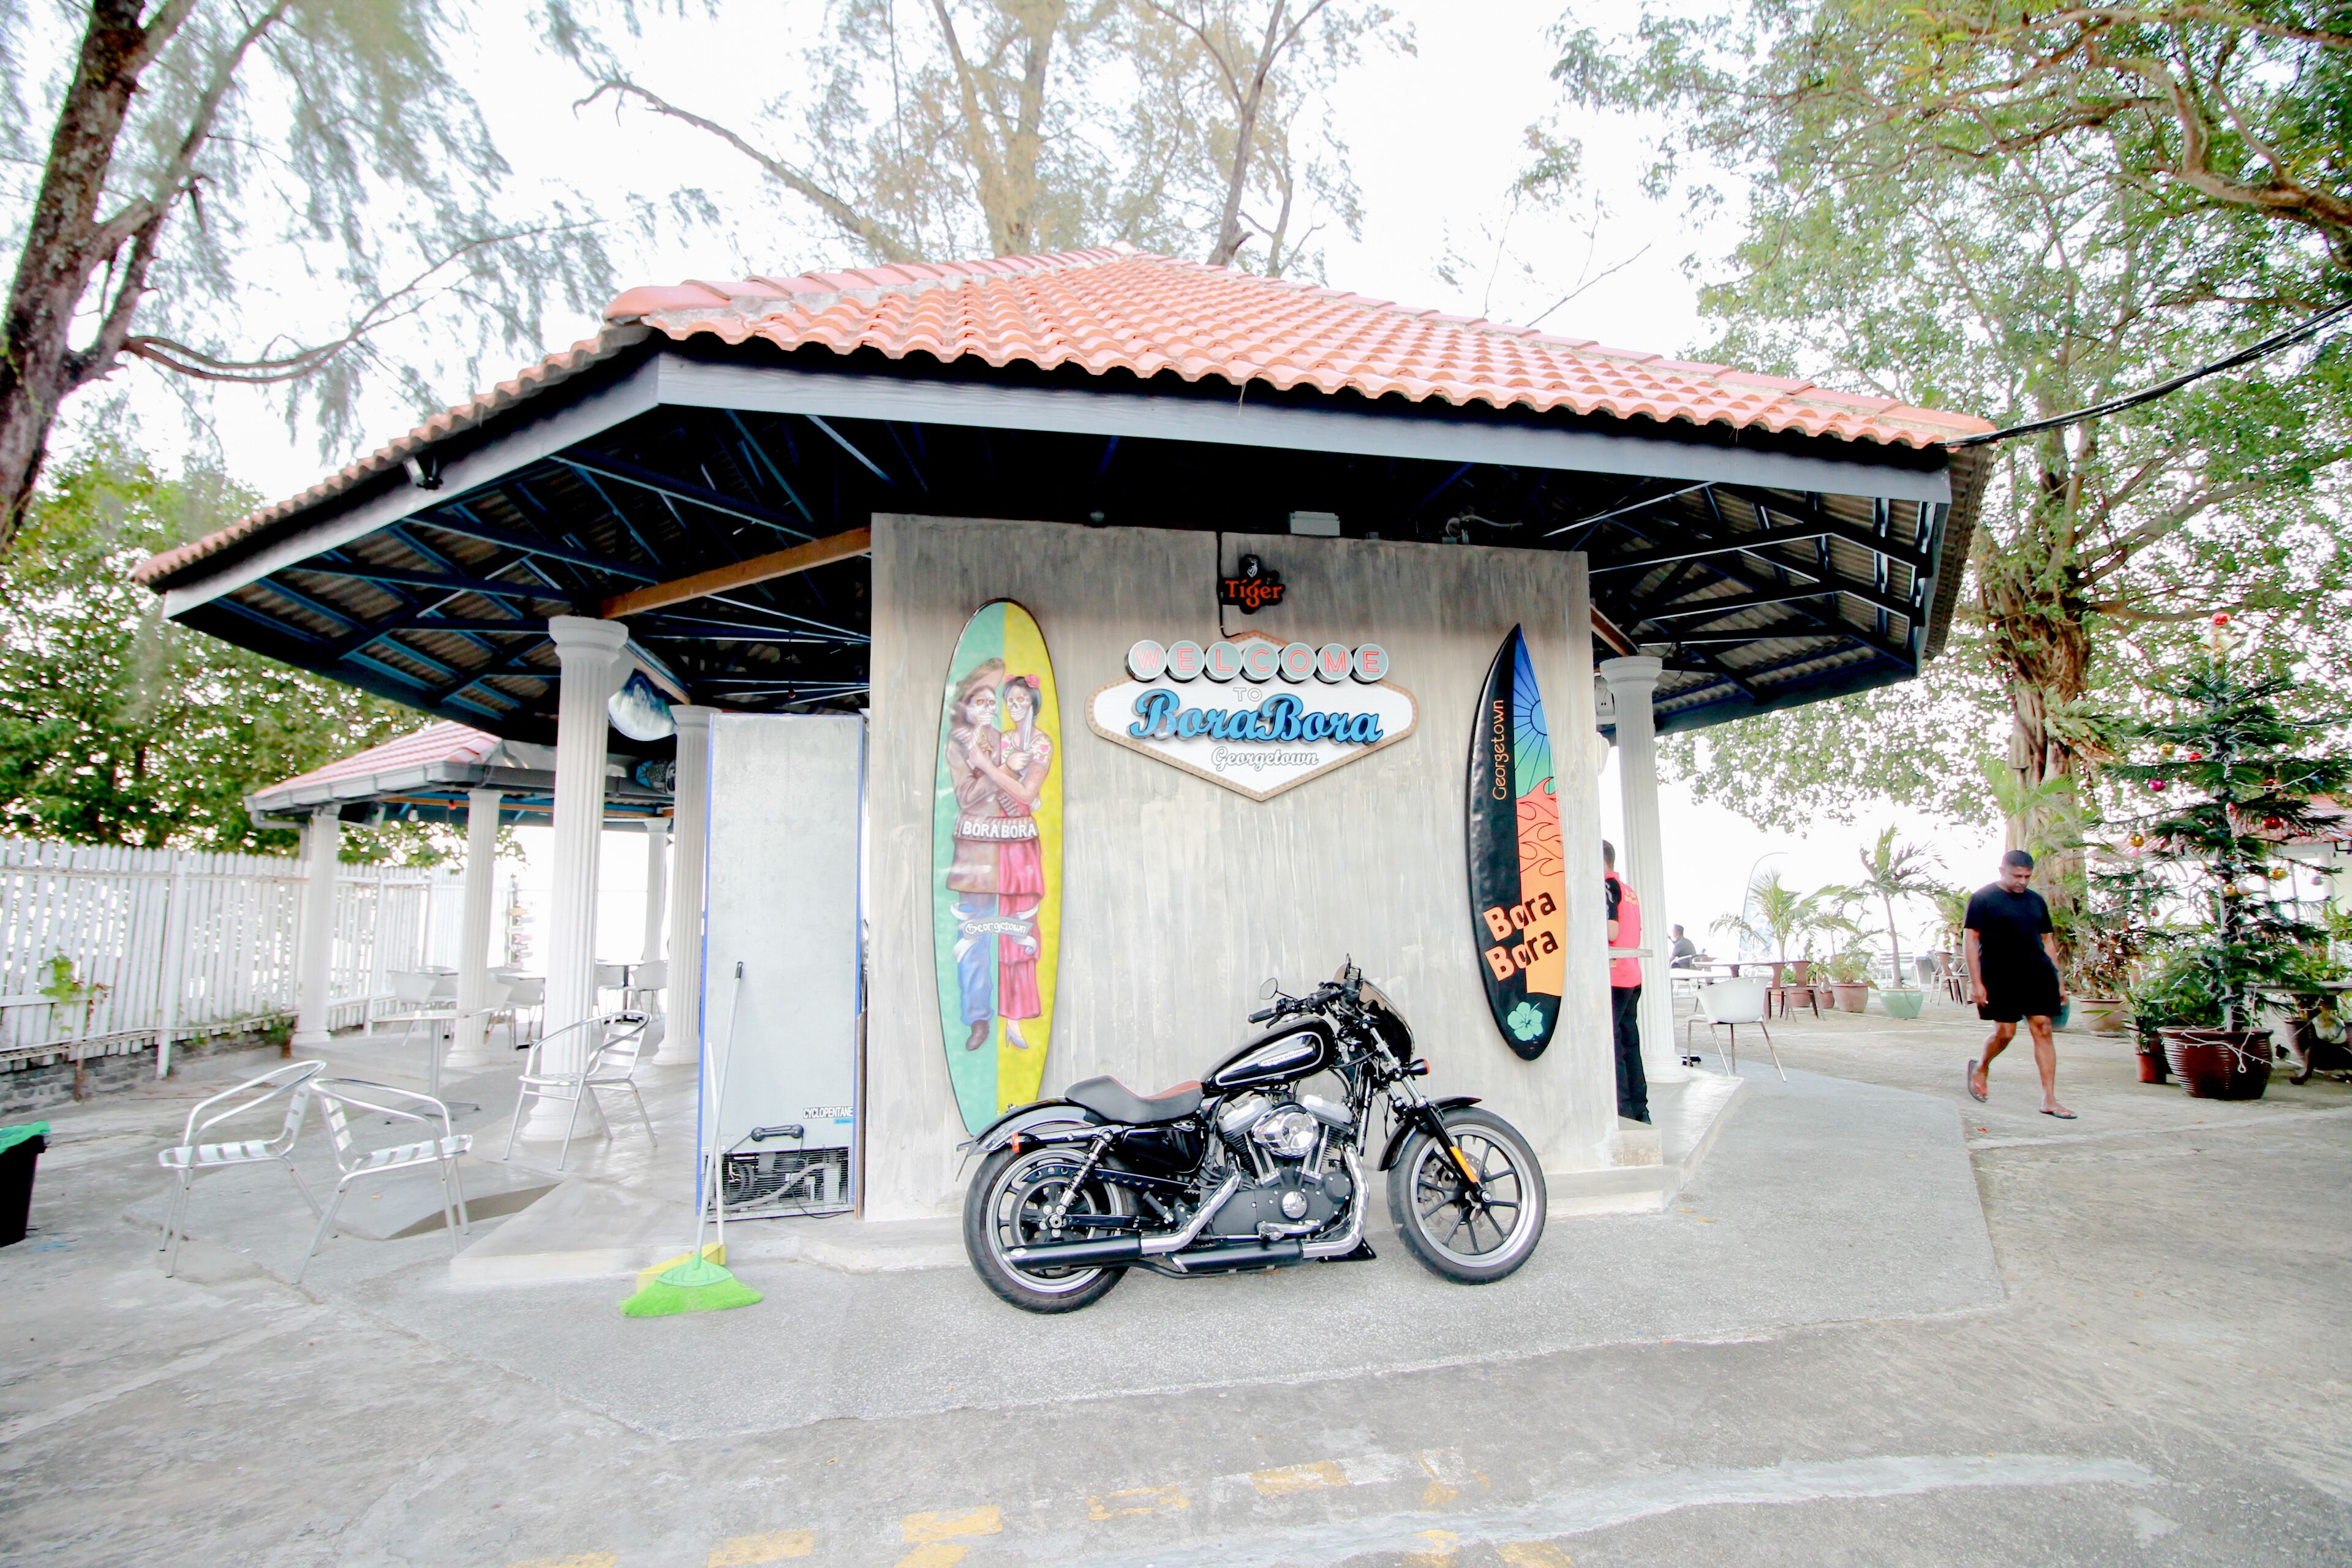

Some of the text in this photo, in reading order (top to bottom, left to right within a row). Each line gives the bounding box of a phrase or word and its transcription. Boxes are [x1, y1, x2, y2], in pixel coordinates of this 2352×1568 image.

[1225, 579, 1284, 608] Tiger
[1134, 647, 1381, 673] WELCOME
[1233, 687, 1263, 703] TO
[1211, 746, 1319, 772] Georgetown
[1493, 699, 1509, 801] Georgetown
[965, 921, 1027, 935] Georgetown
[1483, 892, 1556, 942] Bora
[1485, 930, 1559, 981] Bora
[804, 1107, 853, 1118] CYCLOPENTANE
